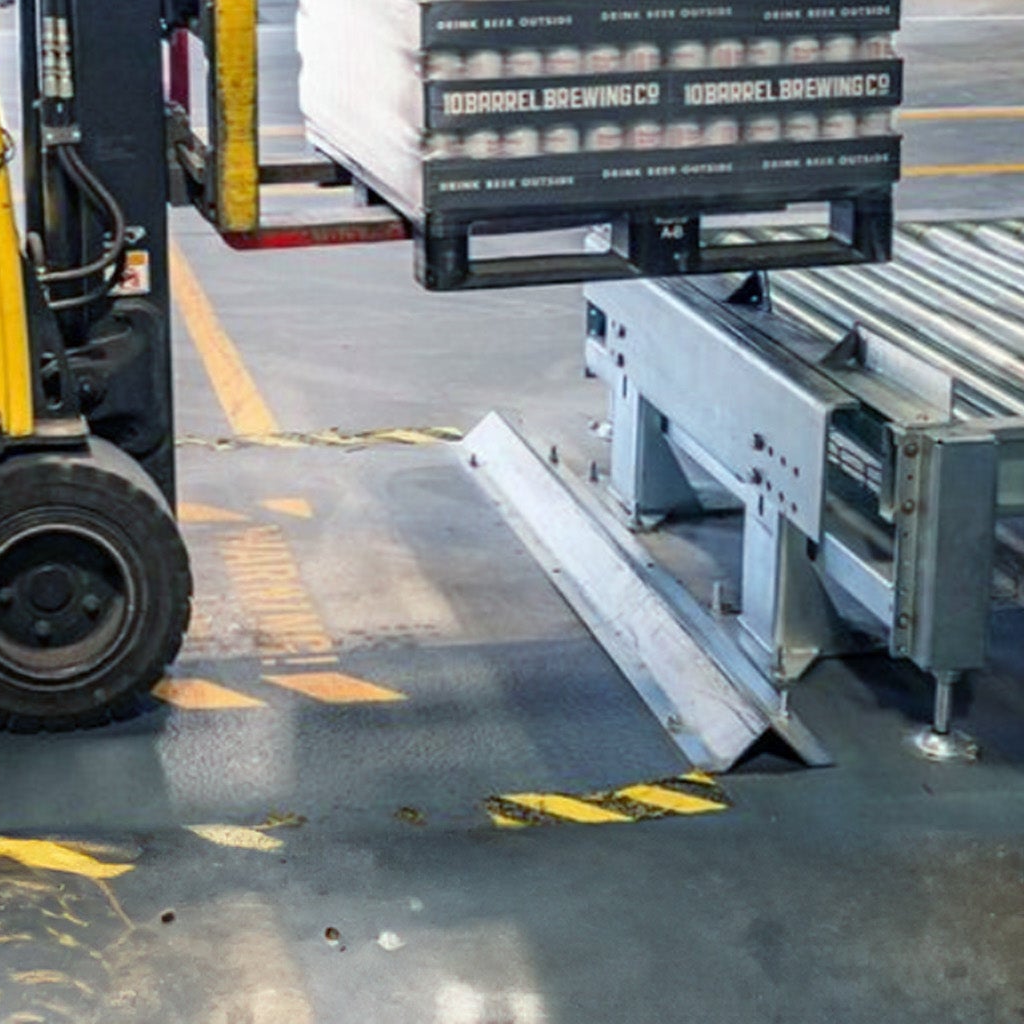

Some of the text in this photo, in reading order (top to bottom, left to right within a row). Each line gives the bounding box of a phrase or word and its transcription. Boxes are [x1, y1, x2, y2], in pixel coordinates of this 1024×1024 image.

[600, 10, 641, 22] DRINK
[679, 6, 733, 19] OUTSIDE
[763, 9, 802, 21] DRINK
[839, 5, 891, 18] OUTSIDE
[436, 19, 478, 32] DRINK
[518, 15, 573, 28] OUTSIDE
[601, 167, 642, 179] DRINK
[680, 162, 733, 175] OUTSIDE
[761, 158, 802, 171] DRINK
[837, 153, 889, 166] OUTSIDE
[438, 179, 481, 192] DRINK
[520, 175, 575, 188] OUTSIDE
